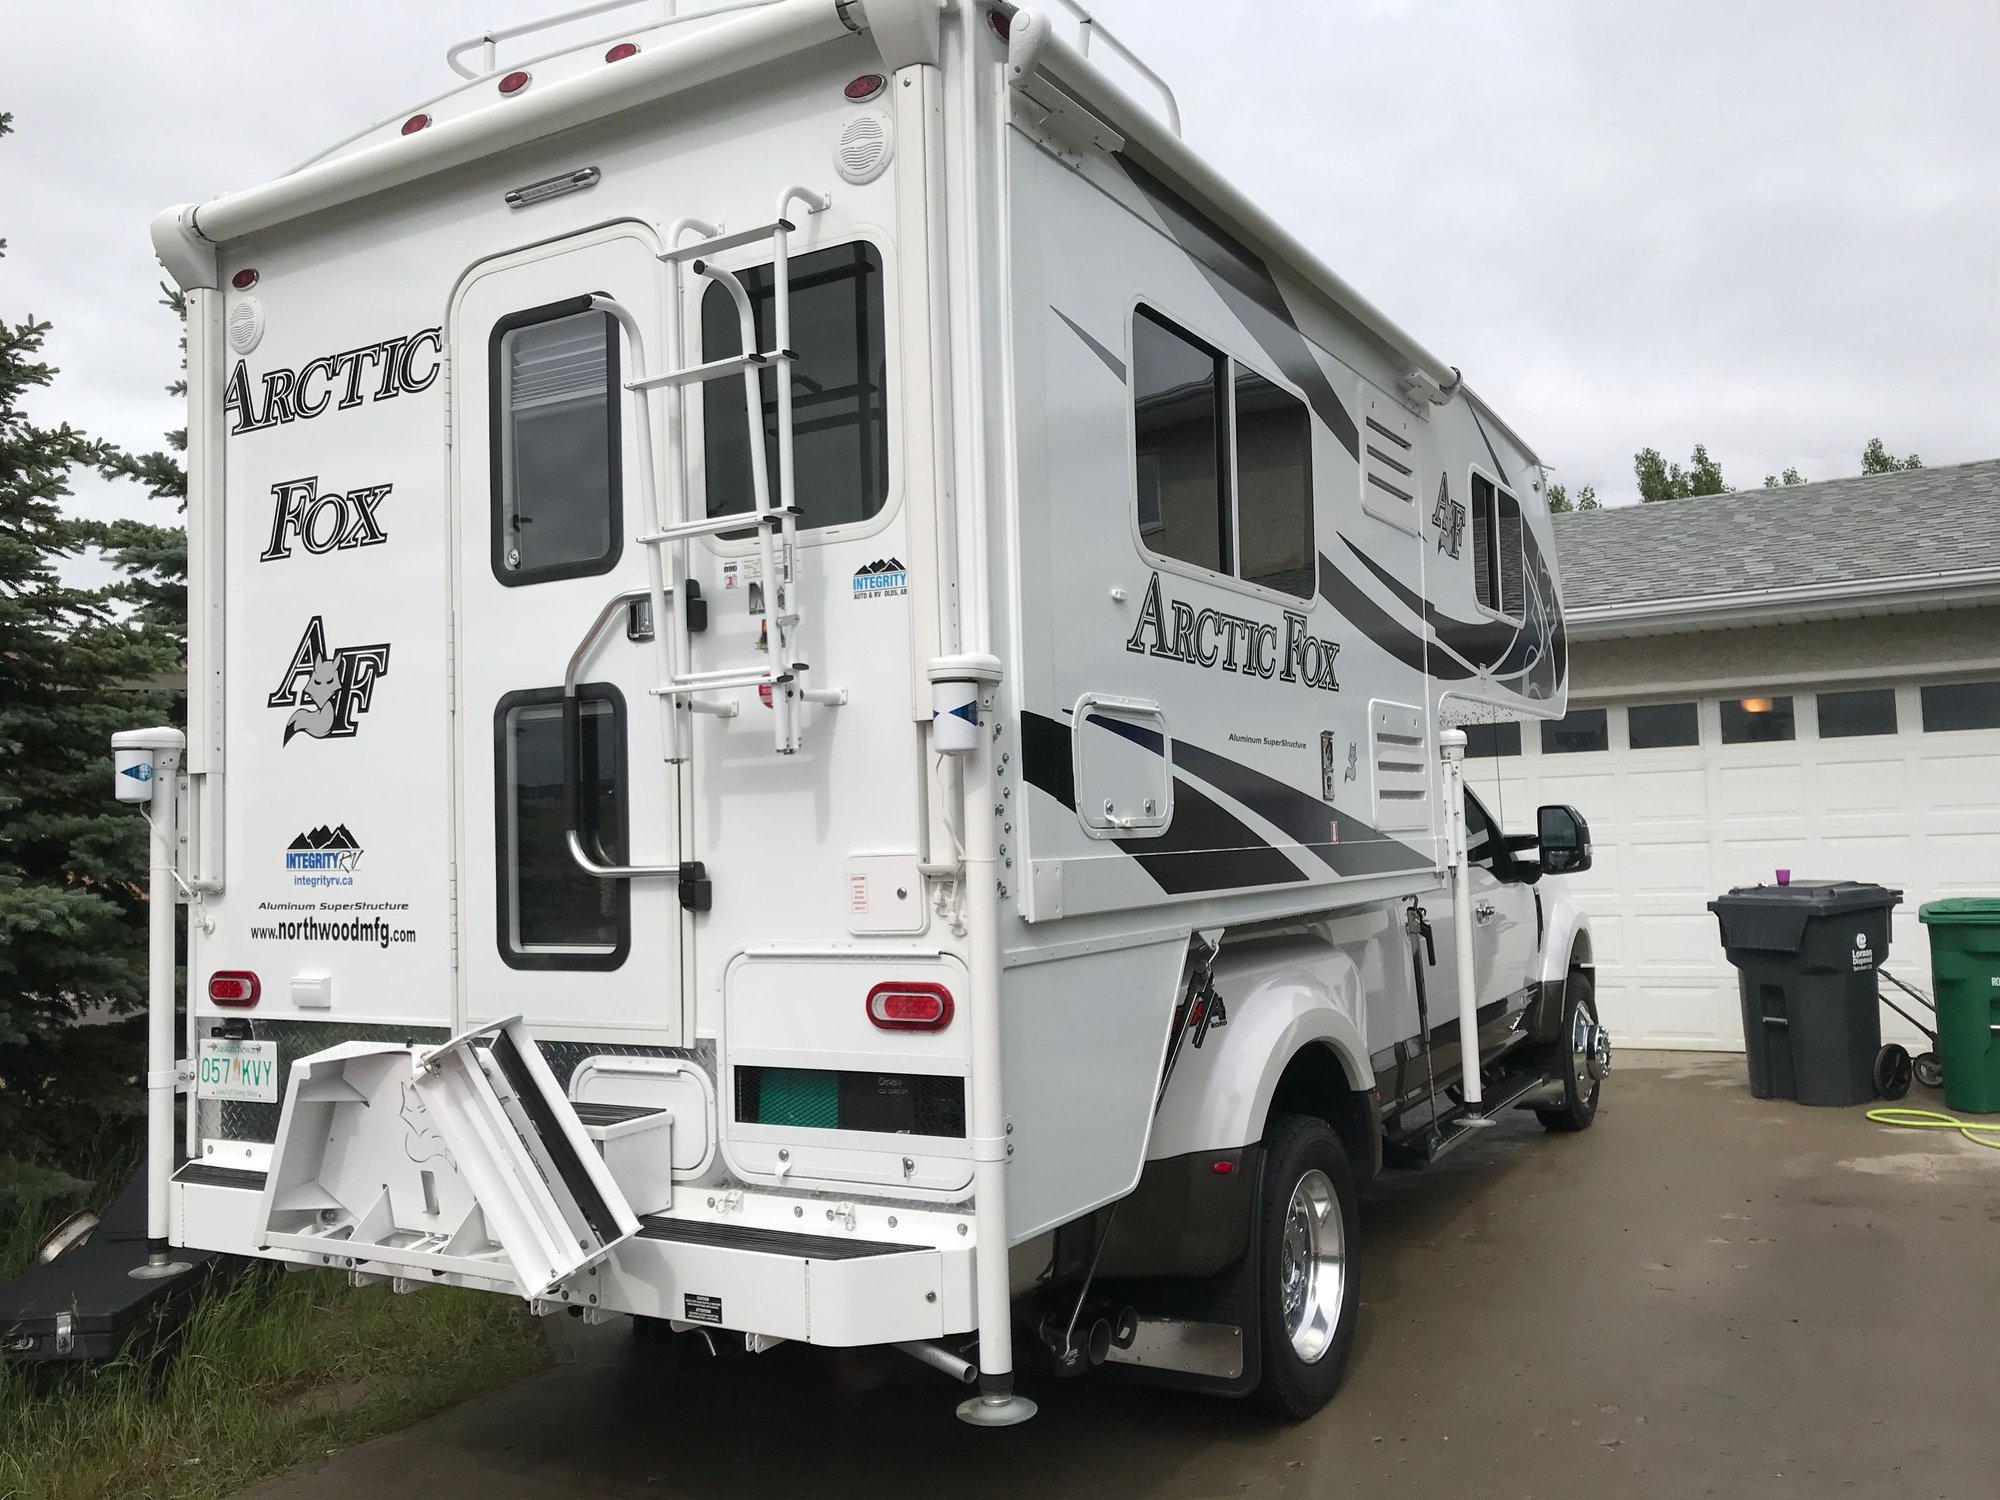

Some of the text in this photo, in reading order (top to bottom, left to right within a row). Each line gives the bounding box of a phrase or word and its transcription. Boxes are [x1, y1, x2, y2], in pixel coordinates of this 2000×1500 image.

[224, 326, 443, 436] ARCTIC
[260, 475, 393, 562] FOX
[853, 573, 907, 591] INTEGRITY
[853, 592, 868, 600] AUTO
[1126, 571, 1340, 692] ARCTIC FOX
[1228, 733, 1307, 749] Aluminum SuperStructure
[294, 875, 353, 887] integrityrv.ca
[258, 902, 409, 912] Aluminum SuperStructure
[251, 916, 416, 949] www.northwoodmfg.com
[202, 1057, 272, 1087] 057 KVY
